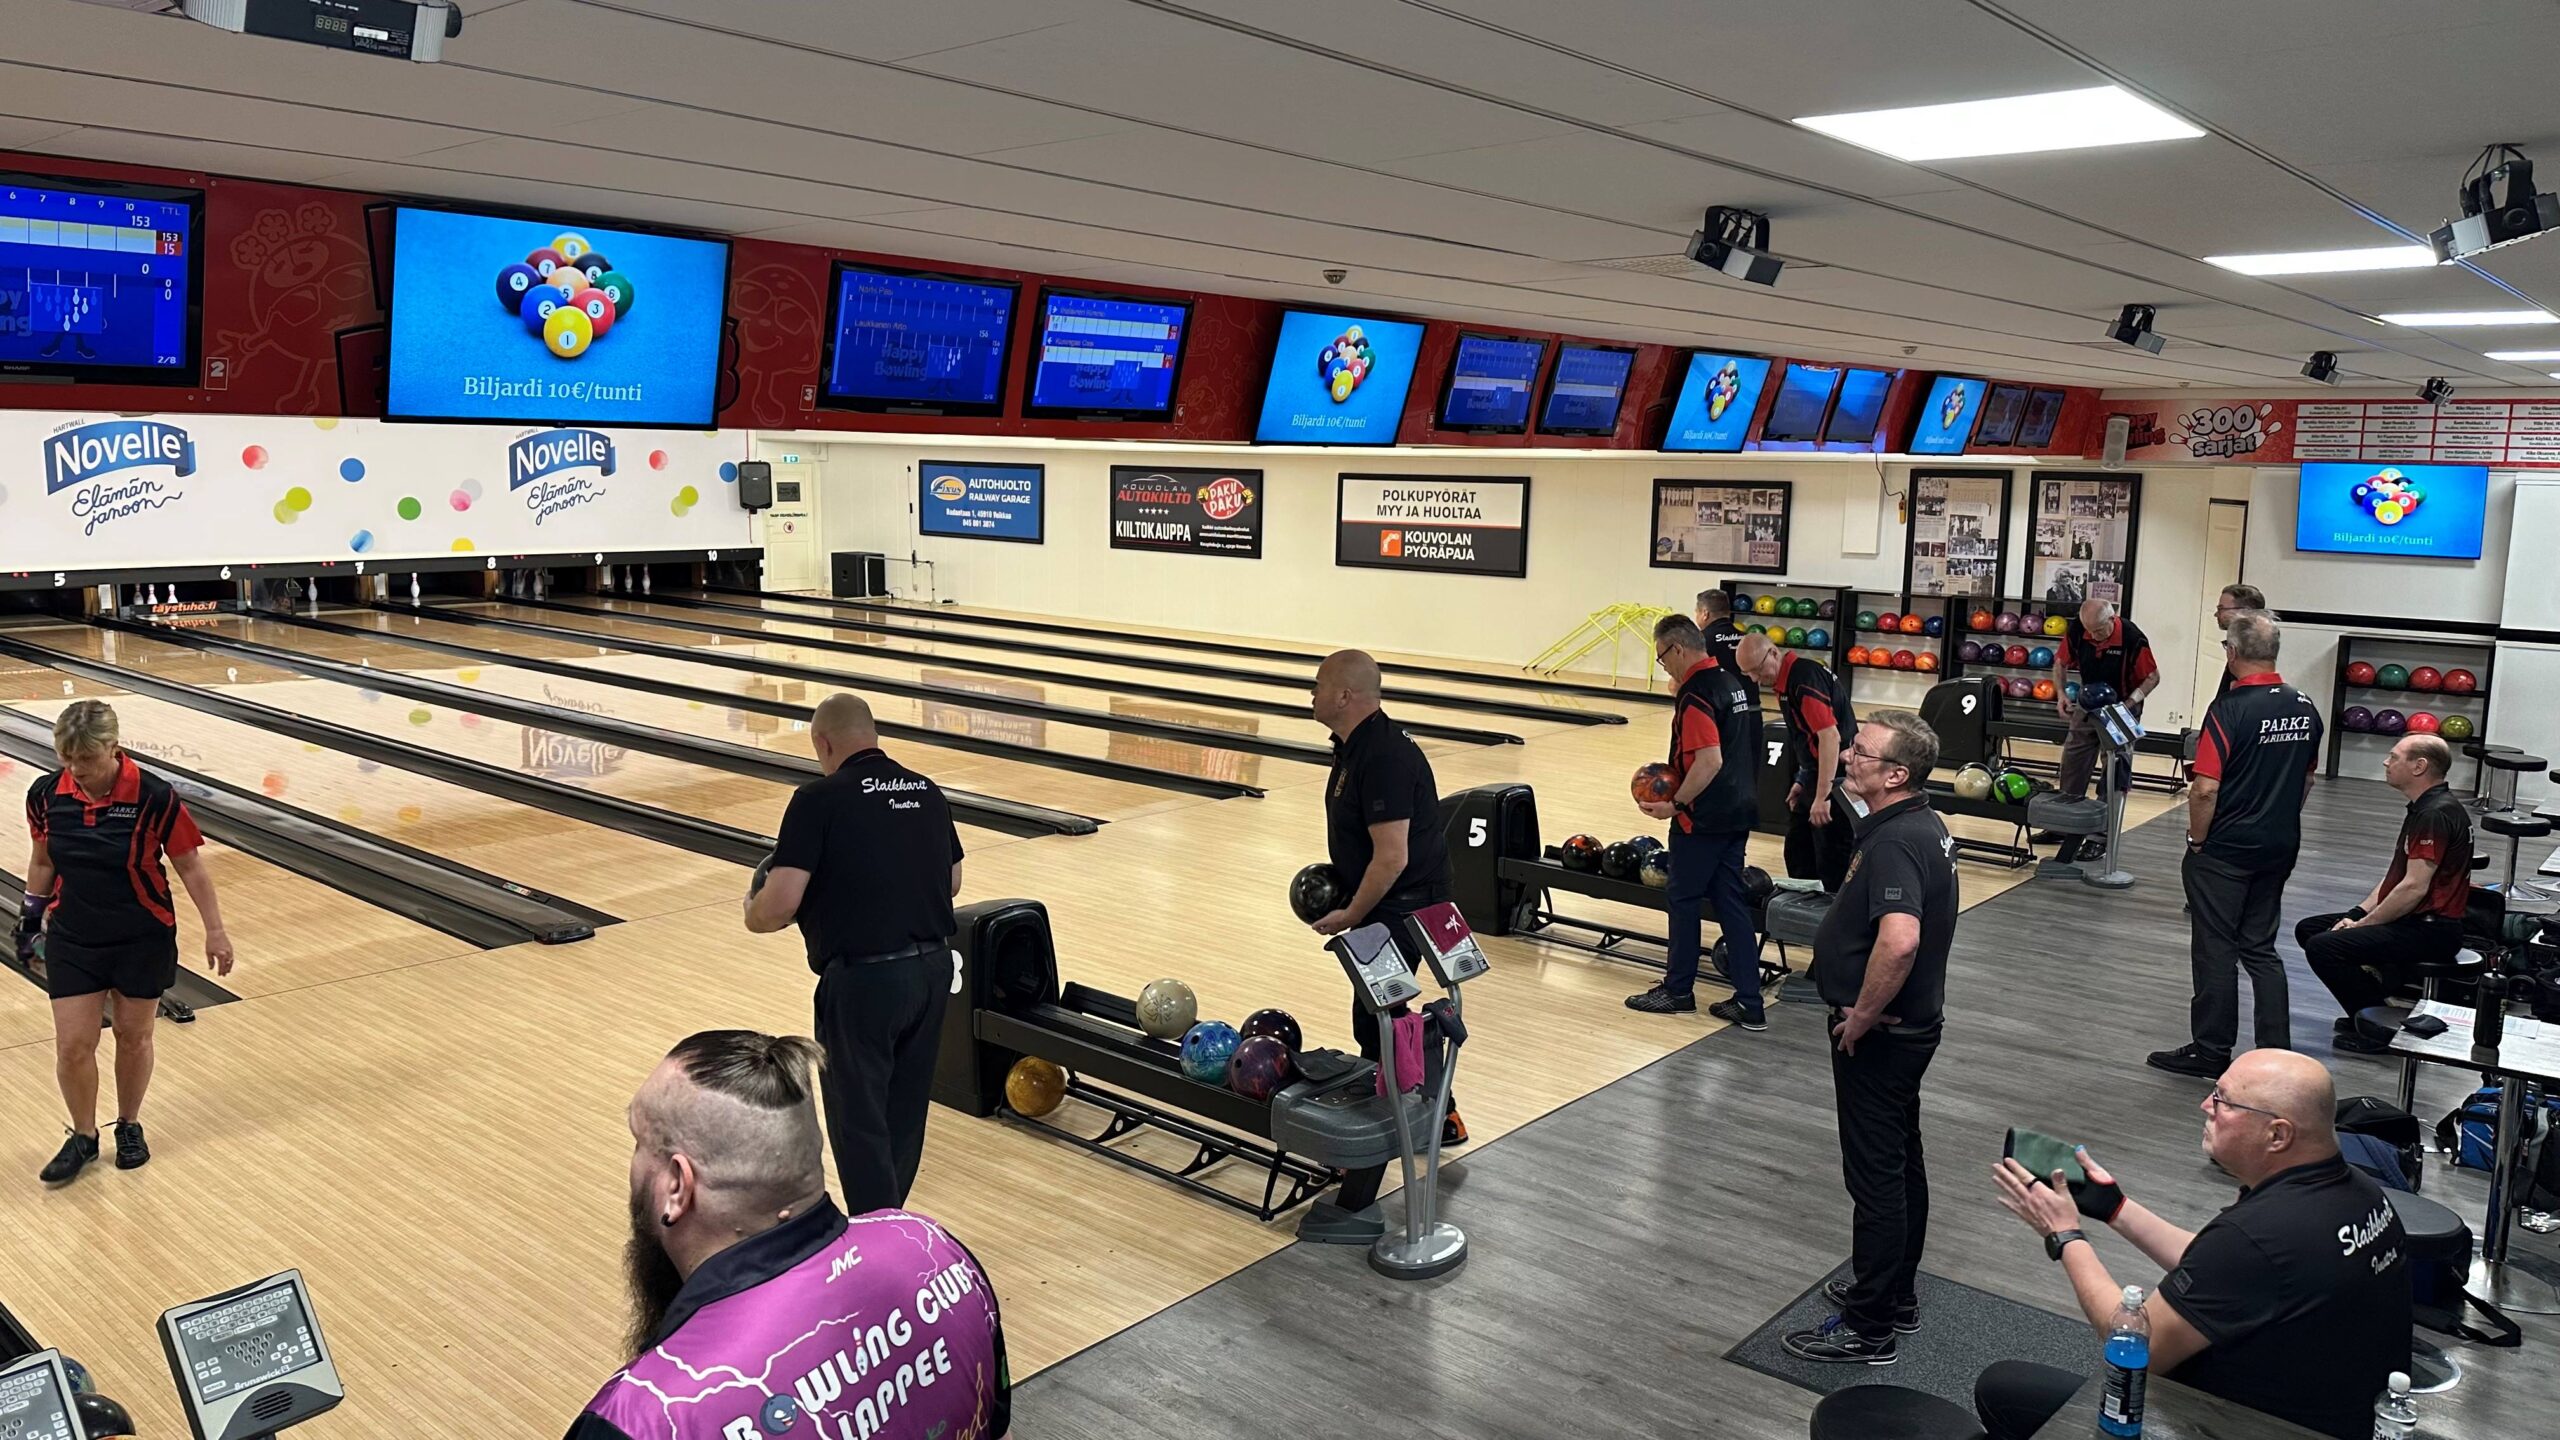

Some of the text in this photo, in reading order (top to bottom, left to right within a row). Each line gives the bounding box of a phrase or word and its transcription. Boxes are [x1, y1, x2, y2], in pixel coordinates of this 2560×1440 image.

[9, 191, 181, 216] 6 7 8 9 10 TTL
[131, 215, 150, 227] 153
[162, 232, 178, 242] 153
[164, 243, 175, 255] 15
[141, 263, 149, 274] 0
[543, 263, 552, 275] 7
[590, 269, 598, 281] 8
[515, 275, 524, 288] 4
[562, 287, 570, 299] 5
[608, 288, 616, 299] 6
[543, 304, 552, 316] 2
[592, 303, 600, 315] 3
[565, 334, 571, 347] 1
[157, 355, 177, 364] 2/8
[210, 360, 225, 378] 2
[874, 361, 928, 381] Bowling
[464, 377, 642, 403] Biljardi 10€/tunti
[1069, 375, 1112, 392] Bowling
[804, 388, 813, 401] 3
[53, 418, 86, 434] HARTWALL
[1292, 414, 1325, 429] Biljardi
[2192, 404, 2256, 435] 300
[2193, 434, 2256, 458] sarjat
[54, 426, 182, 482] Novelle
[516, 433, 606, 481] Novelle
[527, 476, 592, 509] Elämän
[969, 479, 1031, 491] AUTOHUOLTO
[1209, 482, 1237, 500] PAKU
[72, 477, 163, 517] Elämän
[969, 493, 1030, 504] RAILWAY GARAGE
[1116, 490, 1192, 504] AUTOKIILTO
[1382, 488, 1476, 503] POLKUPYÖRÄT
[535, 488, 606, 526] janoon
[1209, 493, 1241, 515] PAKU
[85, 492, 183, 536] janoon
[1377, 505, 1482, 519] MYY JA HUOLTAA
[1116, 520, 1191, 542] KIILTOKAUPPA
[1404, 530, 1472, 546] KOUVOLAN
[2333, 532, 2433, 547] Biljardi 10€/tunti
[594, 552, 604, 566] 9
[708, 550, 718, 562] 10
[1404, 544, 1475, 560] PYÖRÄPAJA
[354, 562, 364, 575] 7
[486, 556, 496, 570] 8
[54, 573, 66, 587] 5
[220, 565, 231, 580] 6
[152, 601, 217, 614] täystuho.fi
[1961, 695, 1976, 714] 9
[2260, 716, 2310, 733] PARKE
[2258, 732, 2310, 745] PARIKKALA
[1767, 741, 1784, 766] 7
[861, 777, 928, 794] Slaikkarit
[888, 798, 920, 809] Imatra
[1468, 817, 1488, 847] 5
[826, 1245, 862, 1283] JMC
[915, 1263, 974, 1325] CLUB
[234, 1368, 281, 1391] Brunswick
[837, 1336, 952, 1440] LAPPEE
